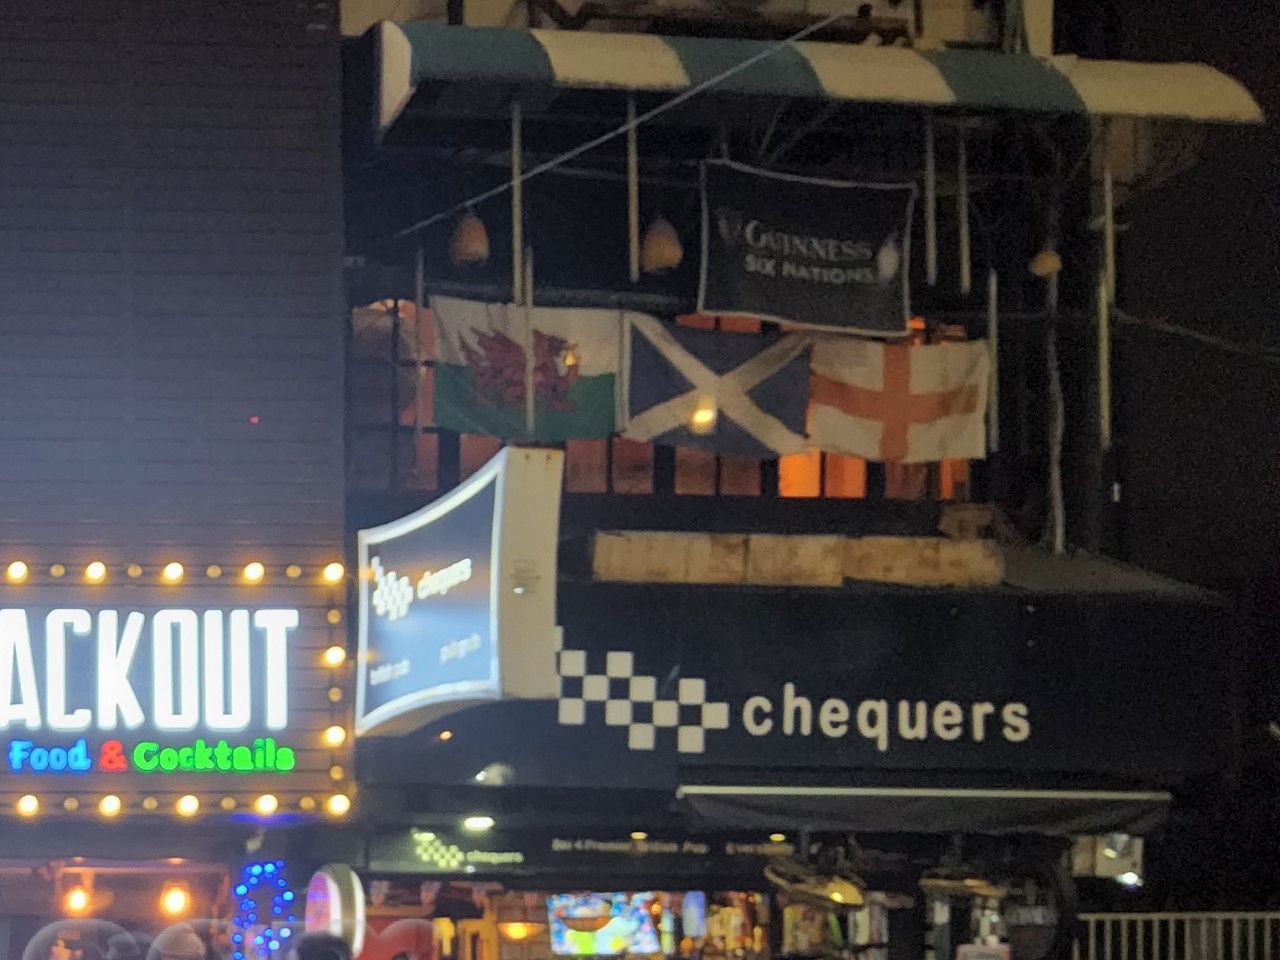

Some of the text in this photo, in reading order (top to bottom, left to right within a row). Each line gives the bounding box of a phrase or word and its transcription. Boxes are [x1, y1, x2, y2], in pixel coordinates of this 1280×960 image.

[744, 253, 875, 285] SIX NATIONS
[742, 682, 1032, 752] chequers
[8, 737, 297, 773] Food & Cocktails
